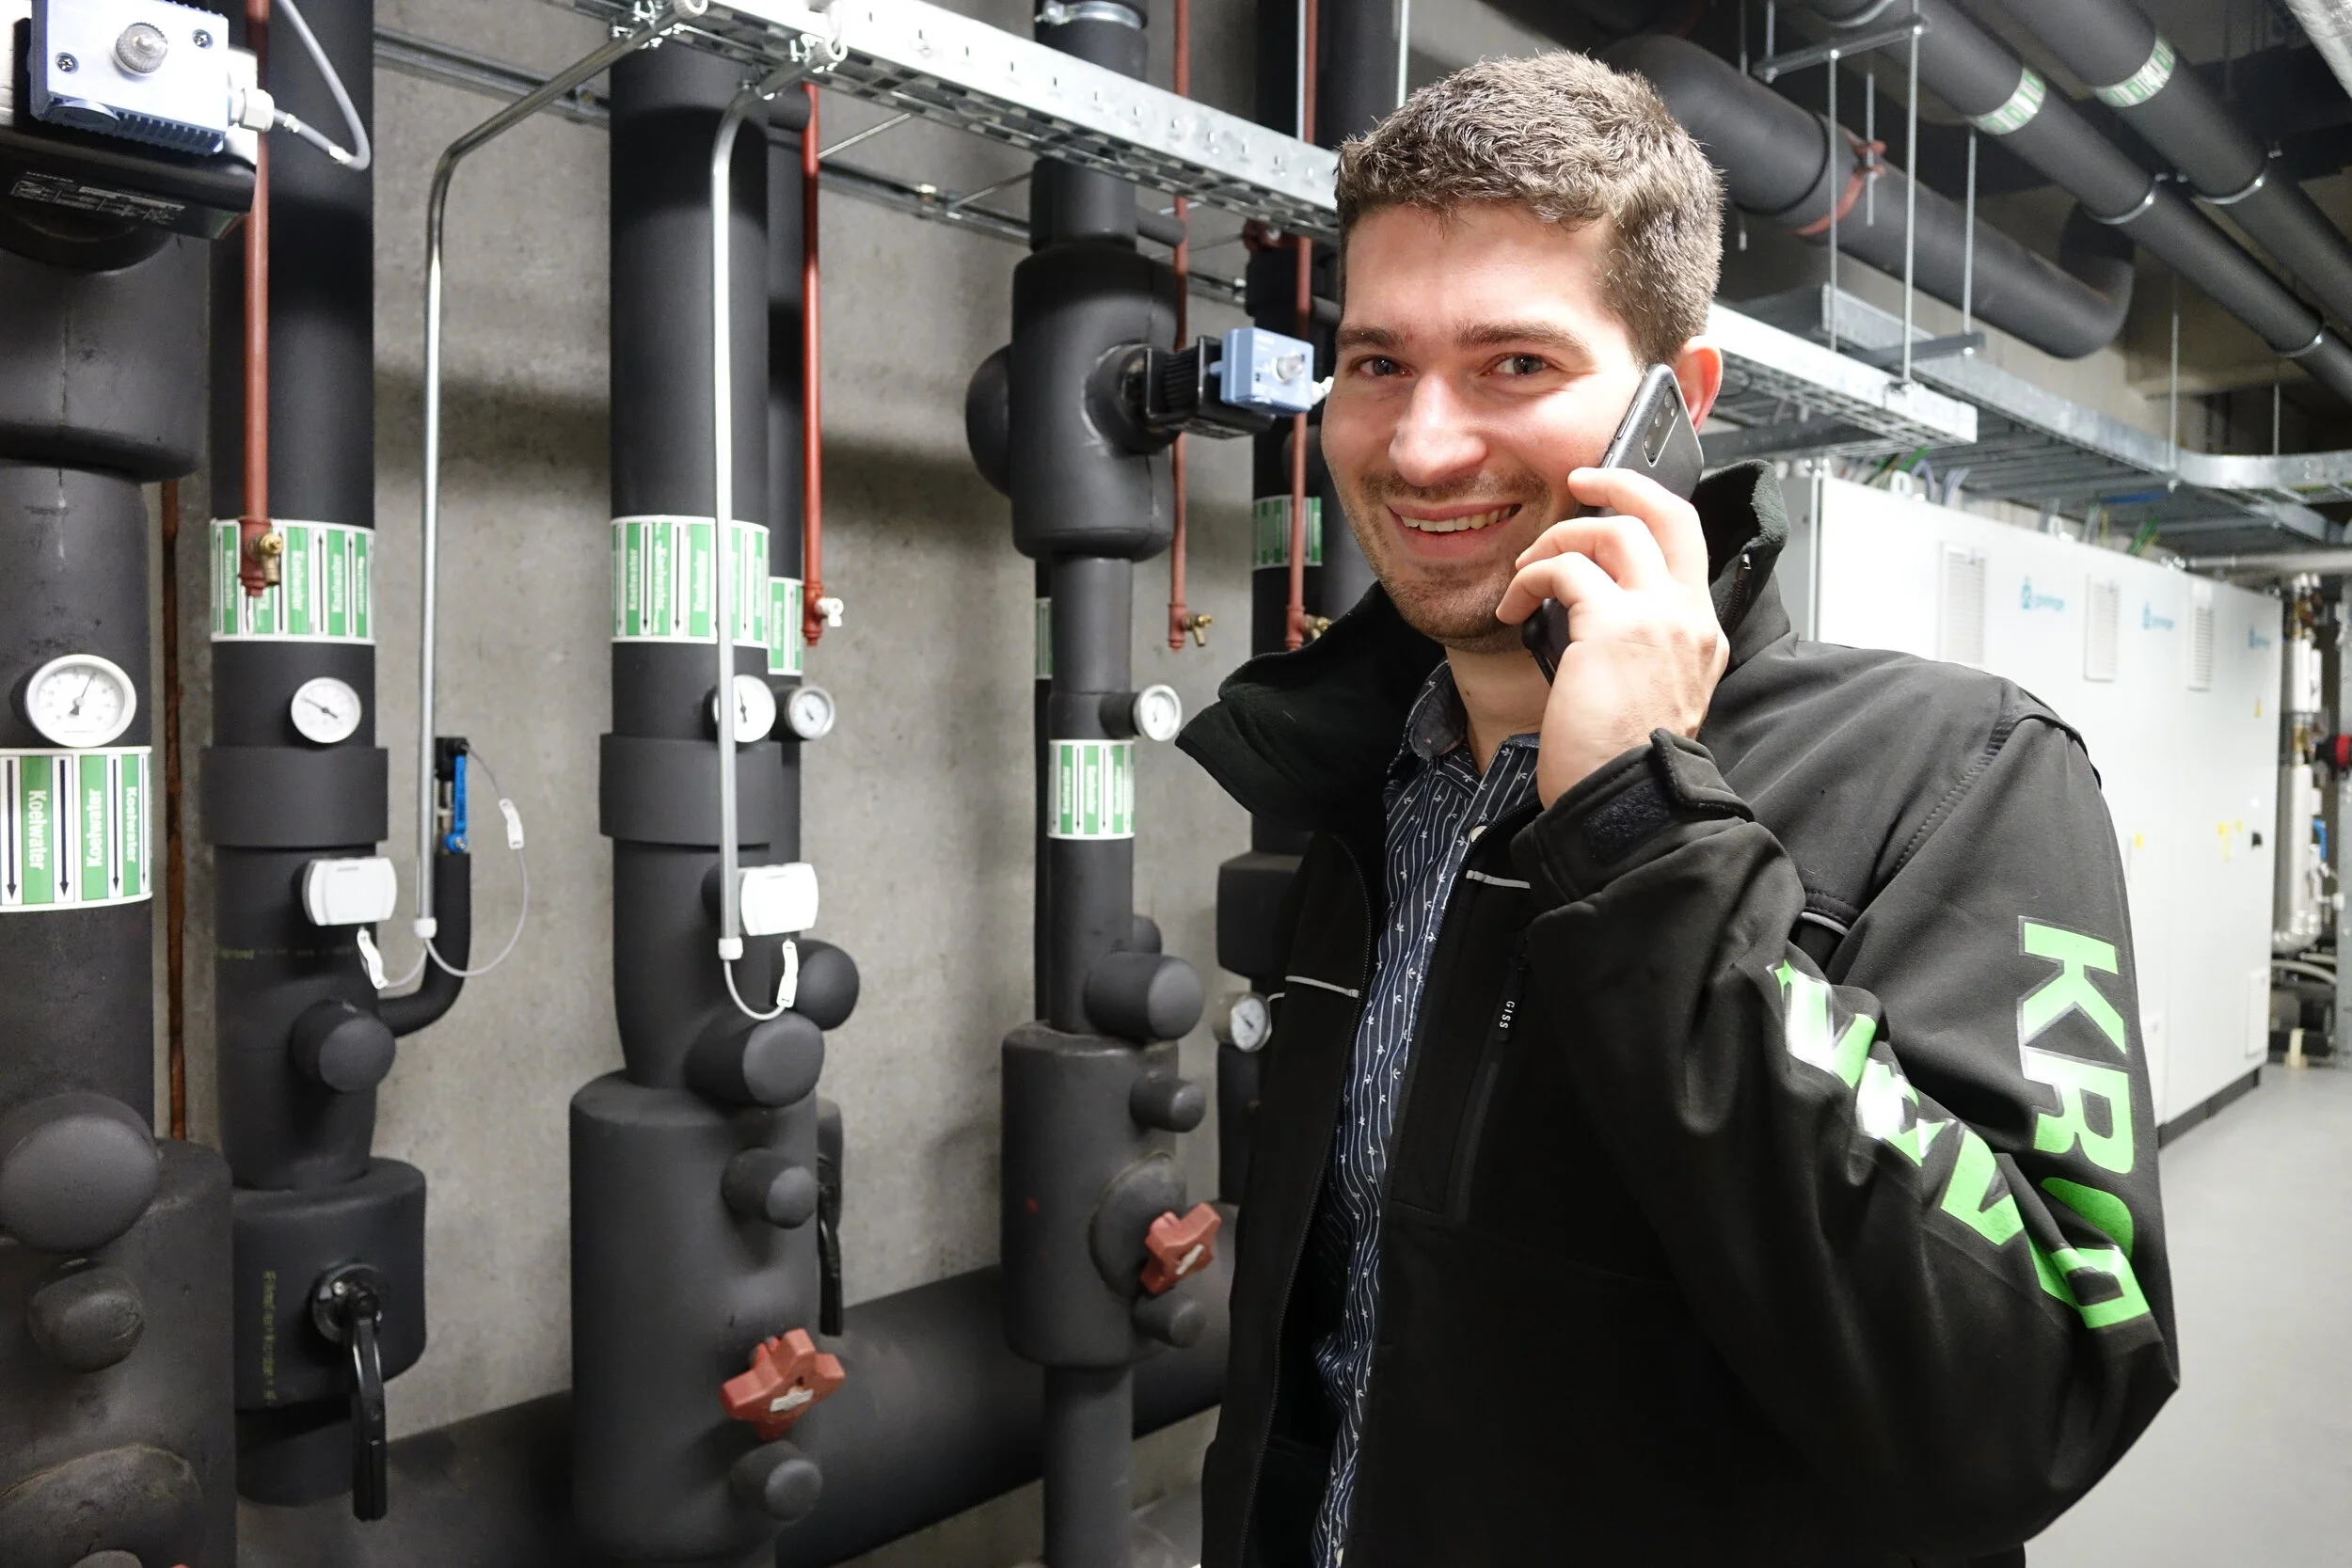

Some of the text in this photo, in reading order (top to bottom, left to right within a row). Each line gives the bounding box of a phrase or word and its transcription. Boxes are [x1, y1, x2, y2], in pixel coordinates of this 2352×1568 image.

[28, 790, 47, 870] Koelwater
[86, 788, 103, 867] Koelwater
[126, 786, 137, 863] Koelwater
[1499, 1000, 1516, 1029] GISS
